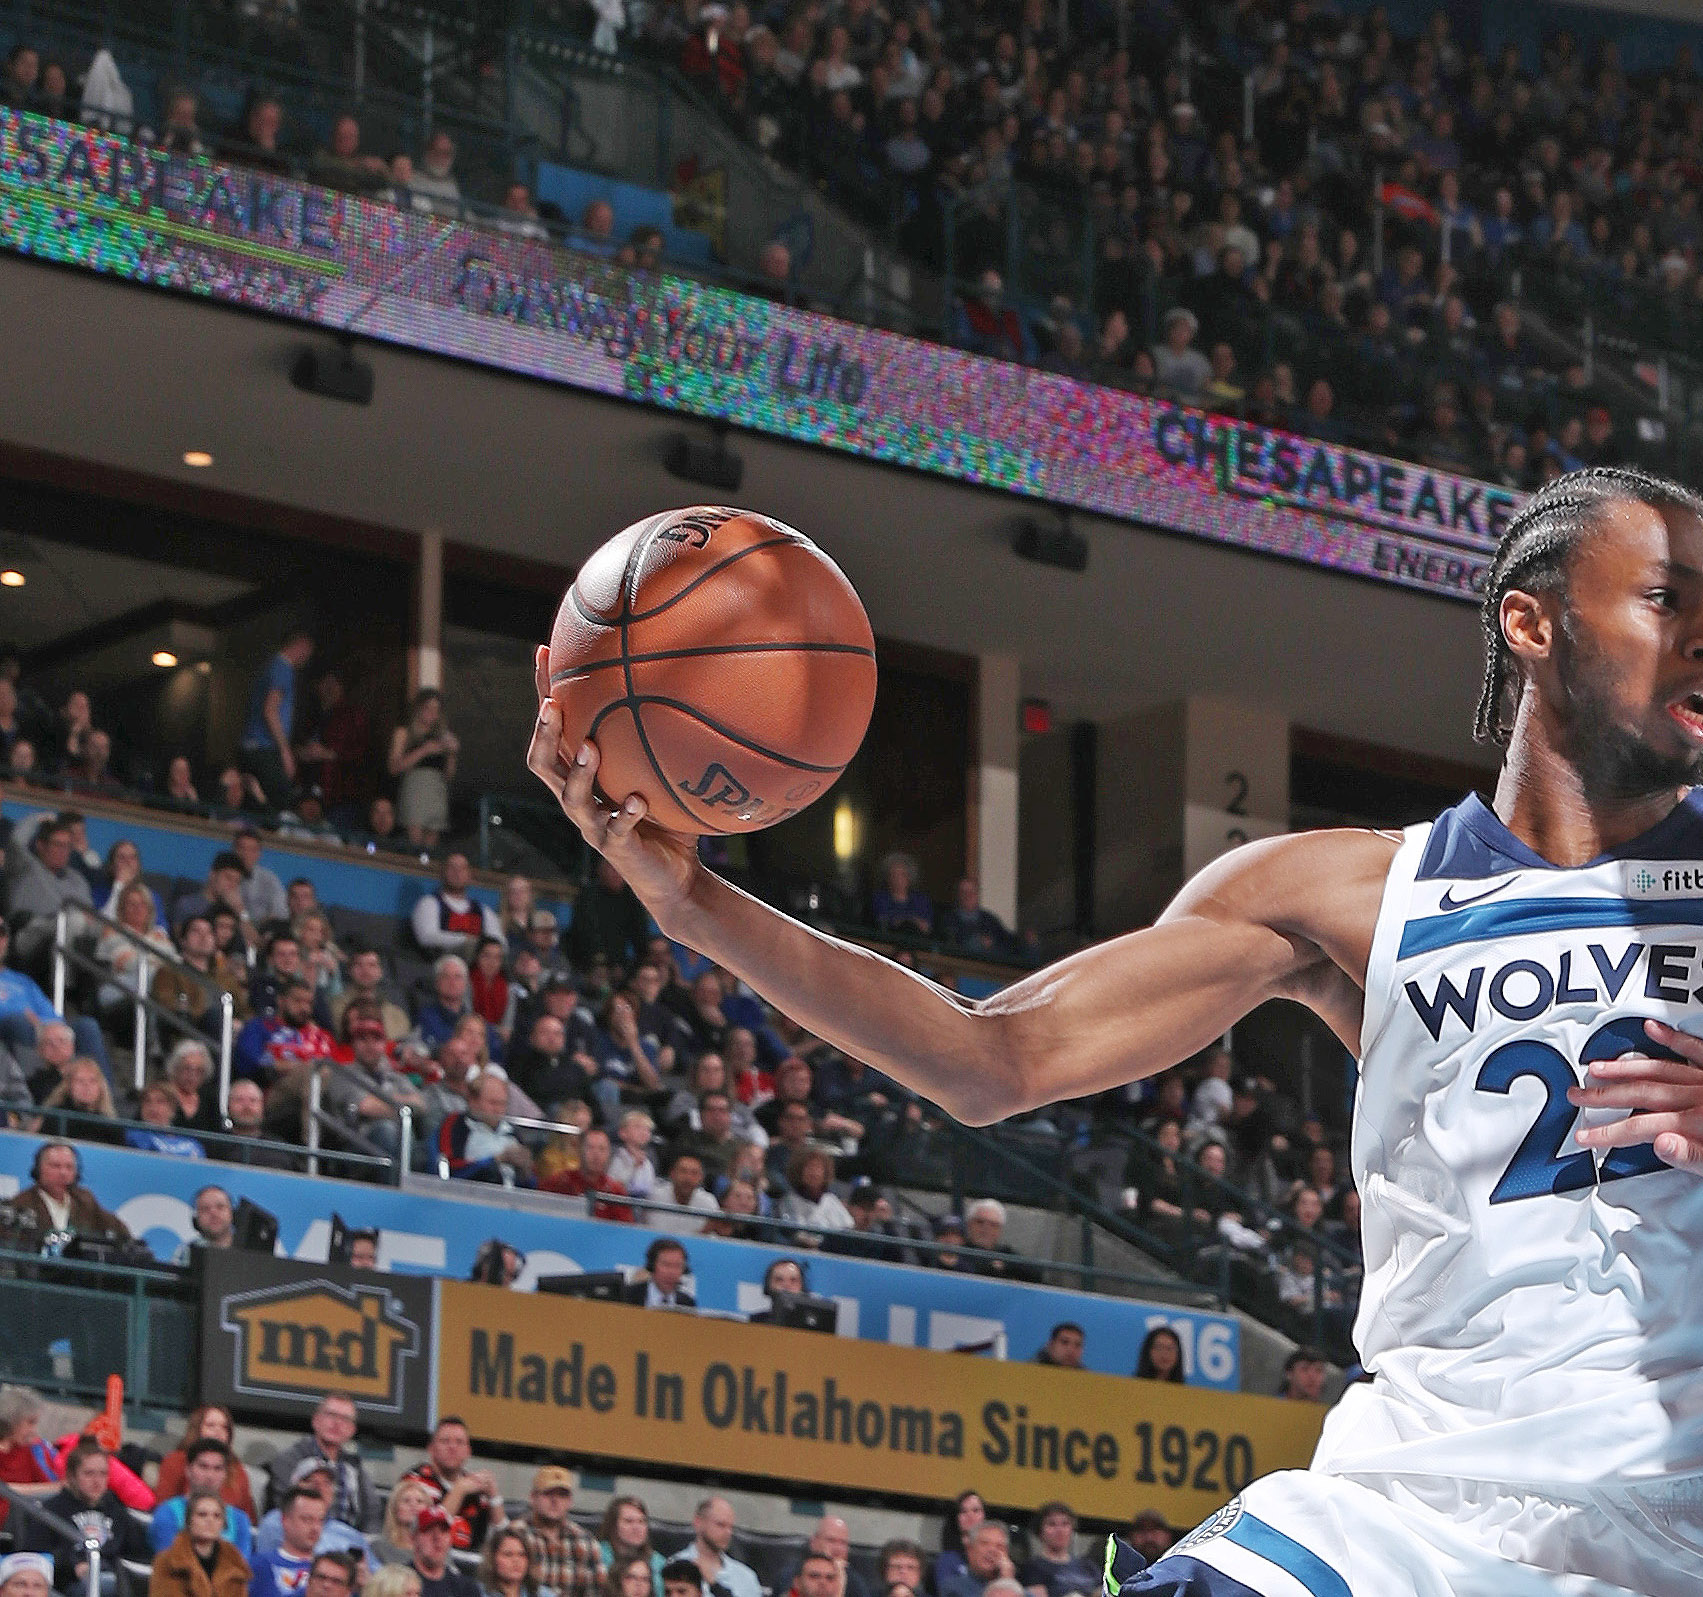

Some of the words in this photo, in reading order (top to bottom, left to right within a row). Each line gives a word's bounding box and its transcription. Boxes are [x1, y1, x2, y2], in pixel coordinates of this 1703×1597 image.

[1154, 409, 1513, 538] CHESAPEAKE
[1371, 540, 1490, 595] ENERG
[468, 1327, 617, 1414] Made
[634, 1349, 685, 1423] In
[702, 1361, 965, 1460] Oklahoma
[980, 1400, 1120, 1480] Since
[1134, 1421, 1256, 1496] 1920
